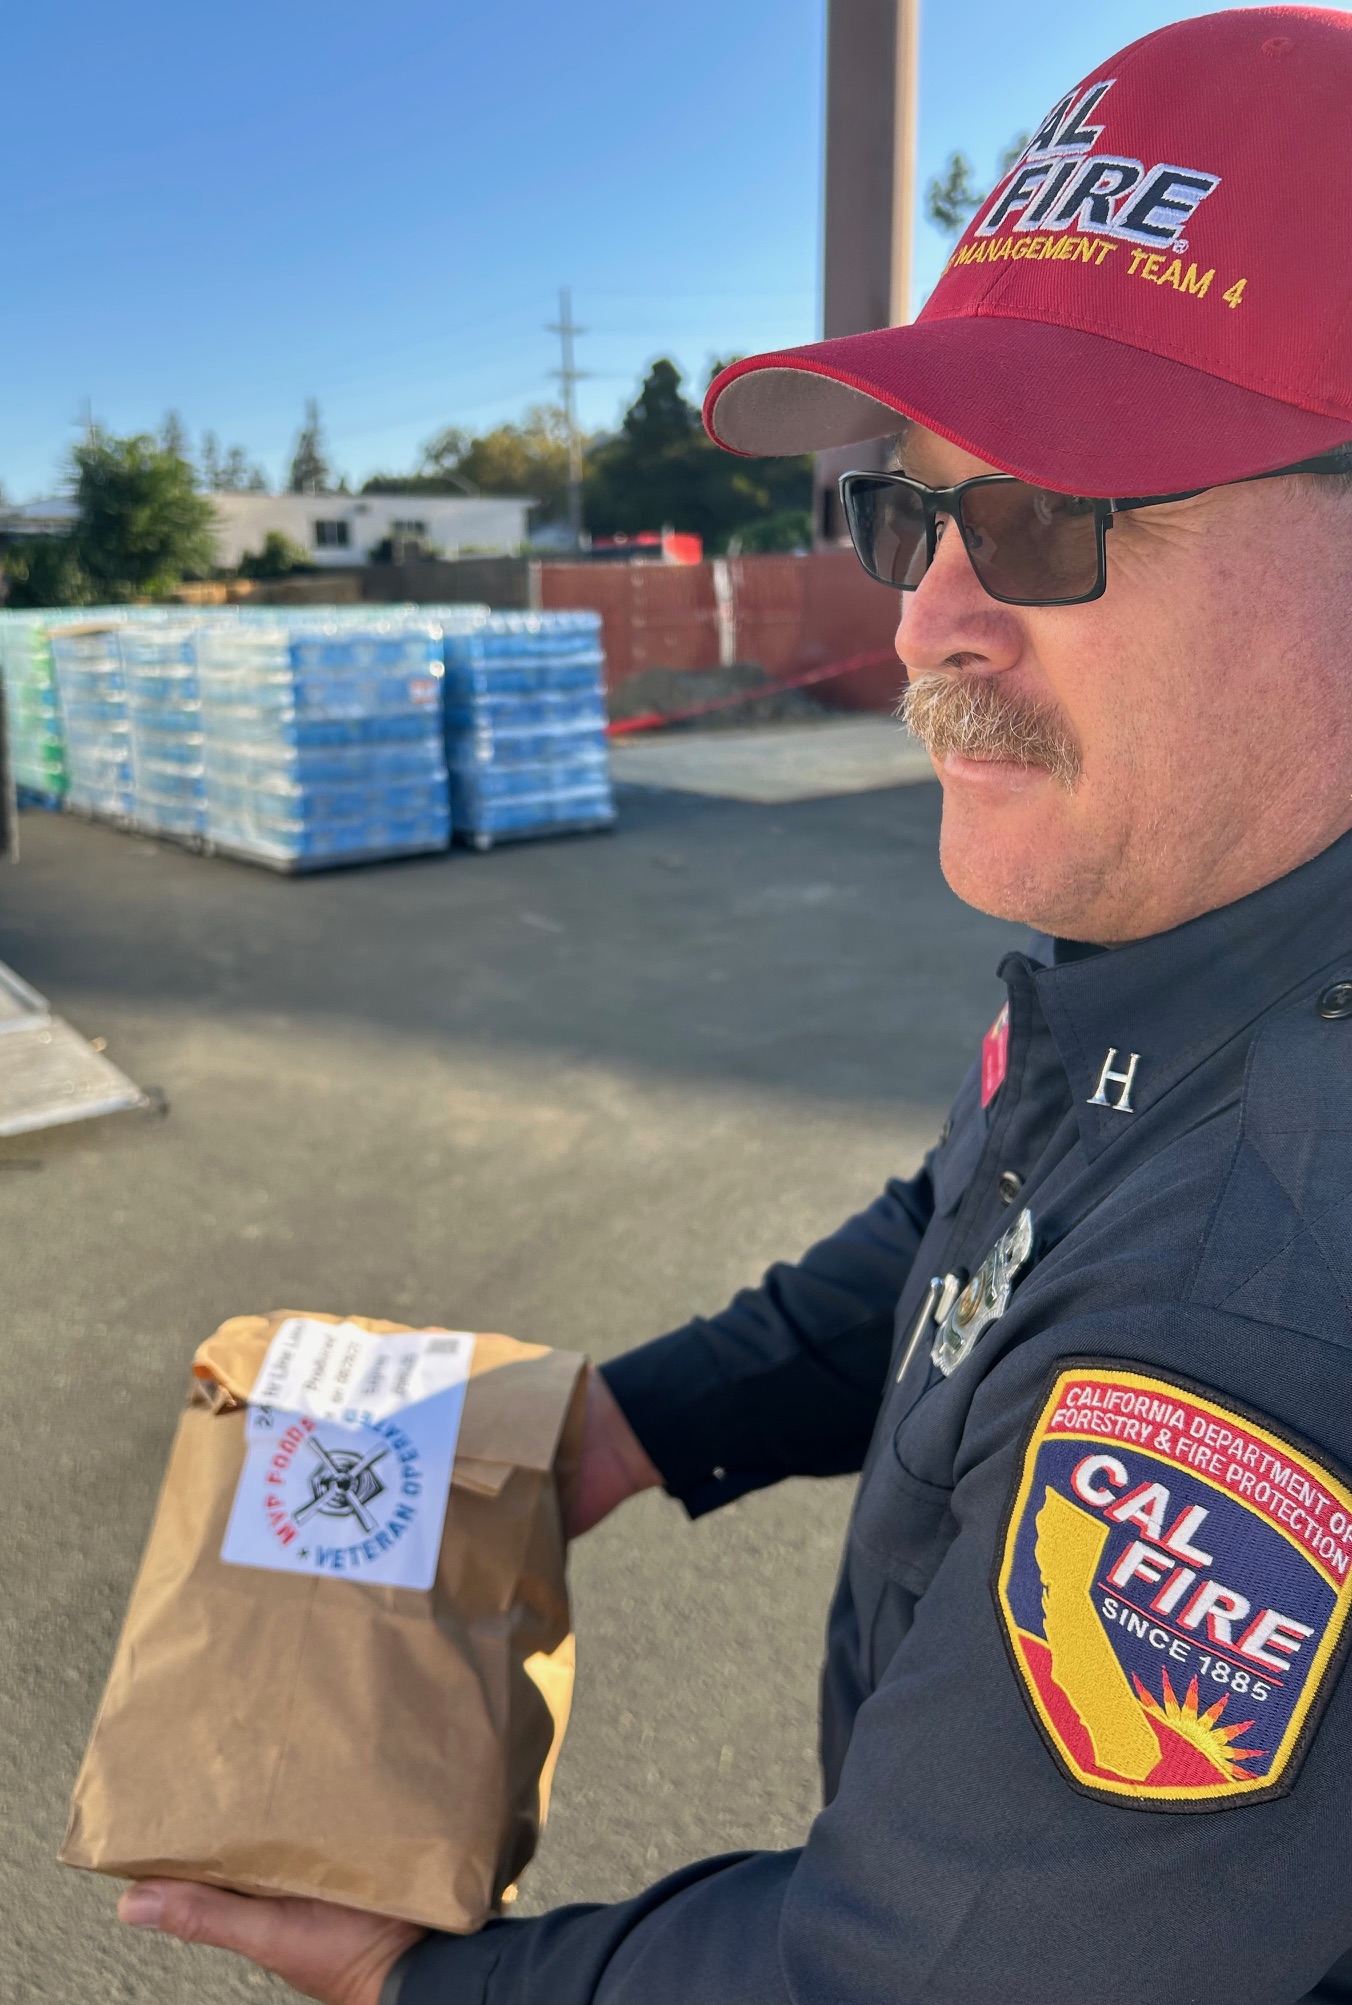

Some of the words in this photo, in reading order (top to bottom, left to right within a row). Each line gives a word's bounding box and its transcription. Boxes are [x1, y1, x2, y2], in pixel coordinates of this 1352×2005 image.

[1020, 79, 1117, 163] AL
[974, 154, 1222, 250] FIRE
[953, 236, 1118, 268] MANAGEMENT
[1127, 247, 1216, 299] TEAM
[1222, 278, 1248, 309] 4
[1087, 1047, 1141, 1113] H
[268, 1416, 317, 1485] FOODS
[344, 1409, 423, 1496] OPERATED
[1051, 1408, 1151, 1444] FORESTRY
[1154, 1429, 1172, 1455] &
[1175, 1437, 1223, 1474] FIRE
[1226, 1463, 1350, 1574] PROTECTION
[1066, 1387, 1185, 1430] CALIFORNIA
[1191, 1416, 1330, 1515] DEPARTMENT
[266, 1496, 297, 1545] MVP
[317, 1504, 416, 1569] VETERAN
[1071, 1453, 1213, 1568] CAL
[1102, 1597, 1191, 1662] SINCE
[1199, 1656, 1271, 1701] 1885
[1106, 1540, 1315, 1673] FIRE
